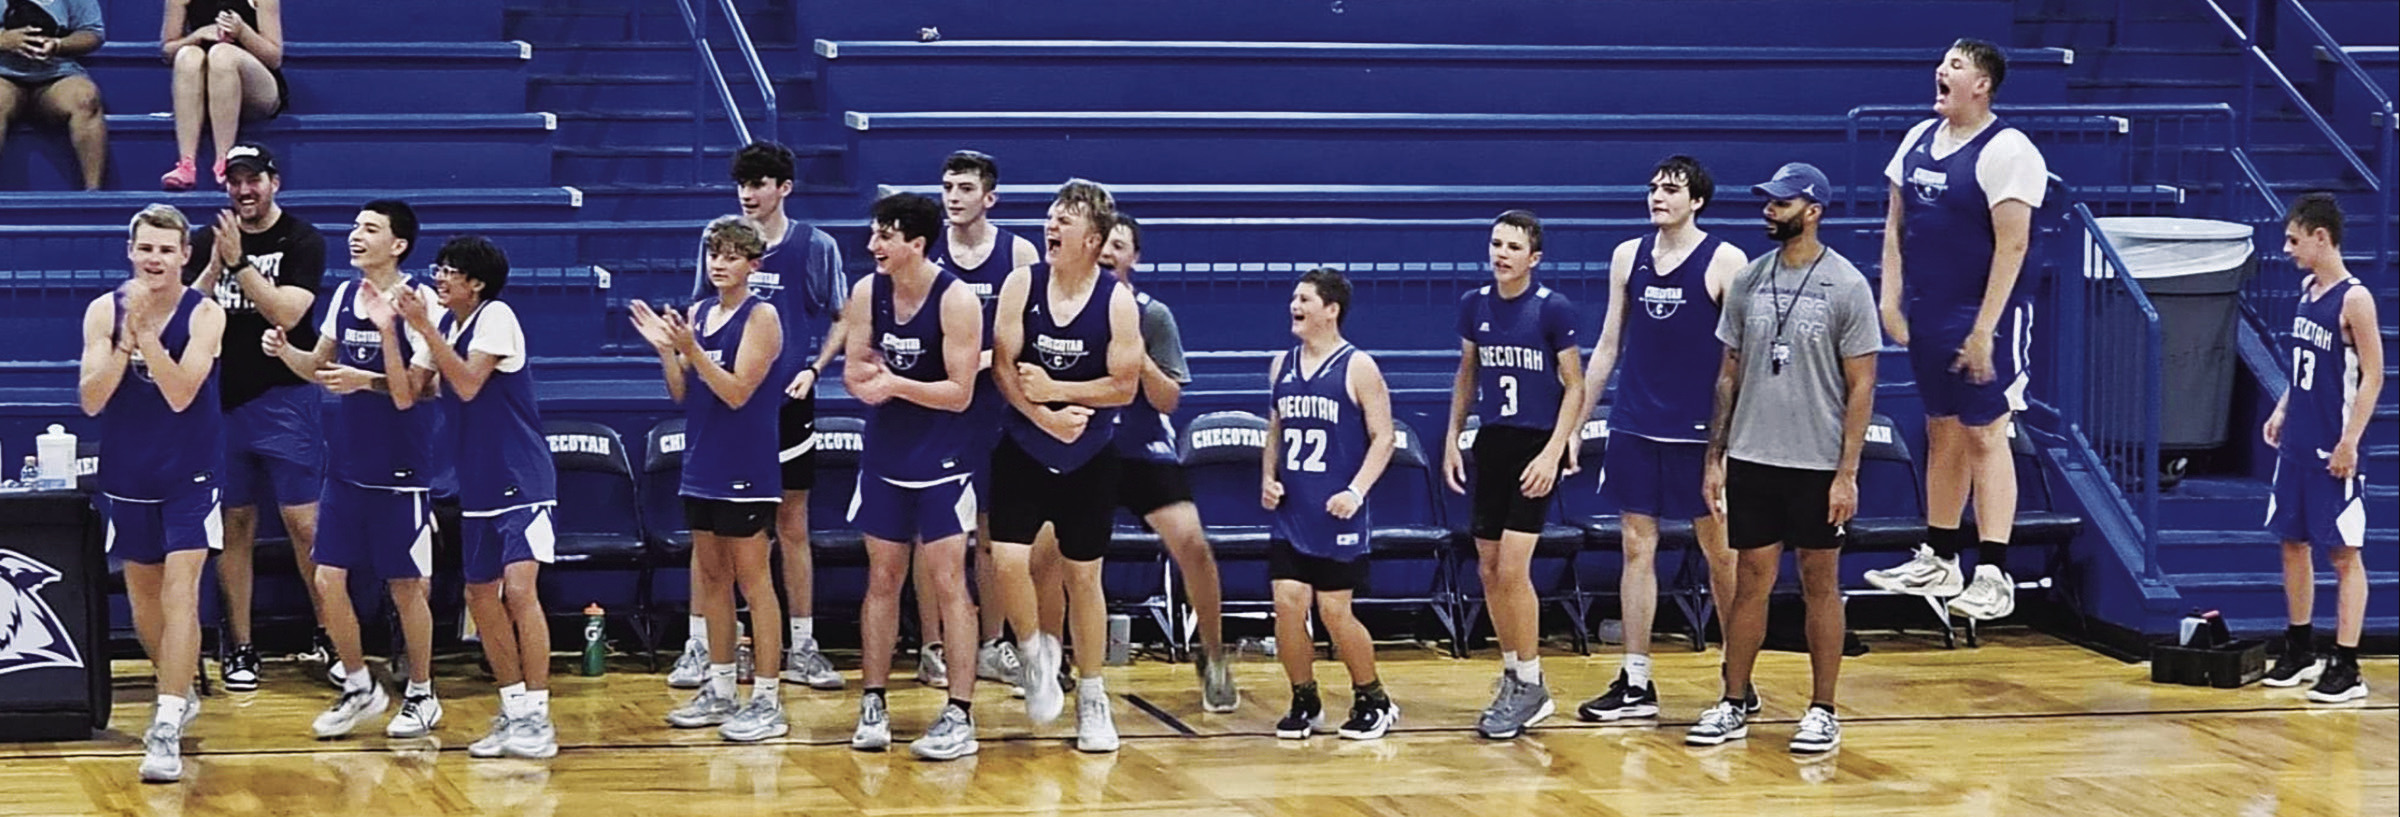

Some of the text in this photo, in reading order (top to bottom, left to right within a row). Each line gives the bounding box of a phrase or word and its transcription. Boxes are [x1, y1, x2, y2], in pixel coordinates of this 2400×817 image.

[2293, 346, 2316, 391] 13
[1499, 375, 1518, 416] 3
[545, 434, 610, 455] ECOTAH
[815, 432, 864, 451] ECOTA
[1284, 428, 1327, 472] 22
[584, 625, 599, 642] G
